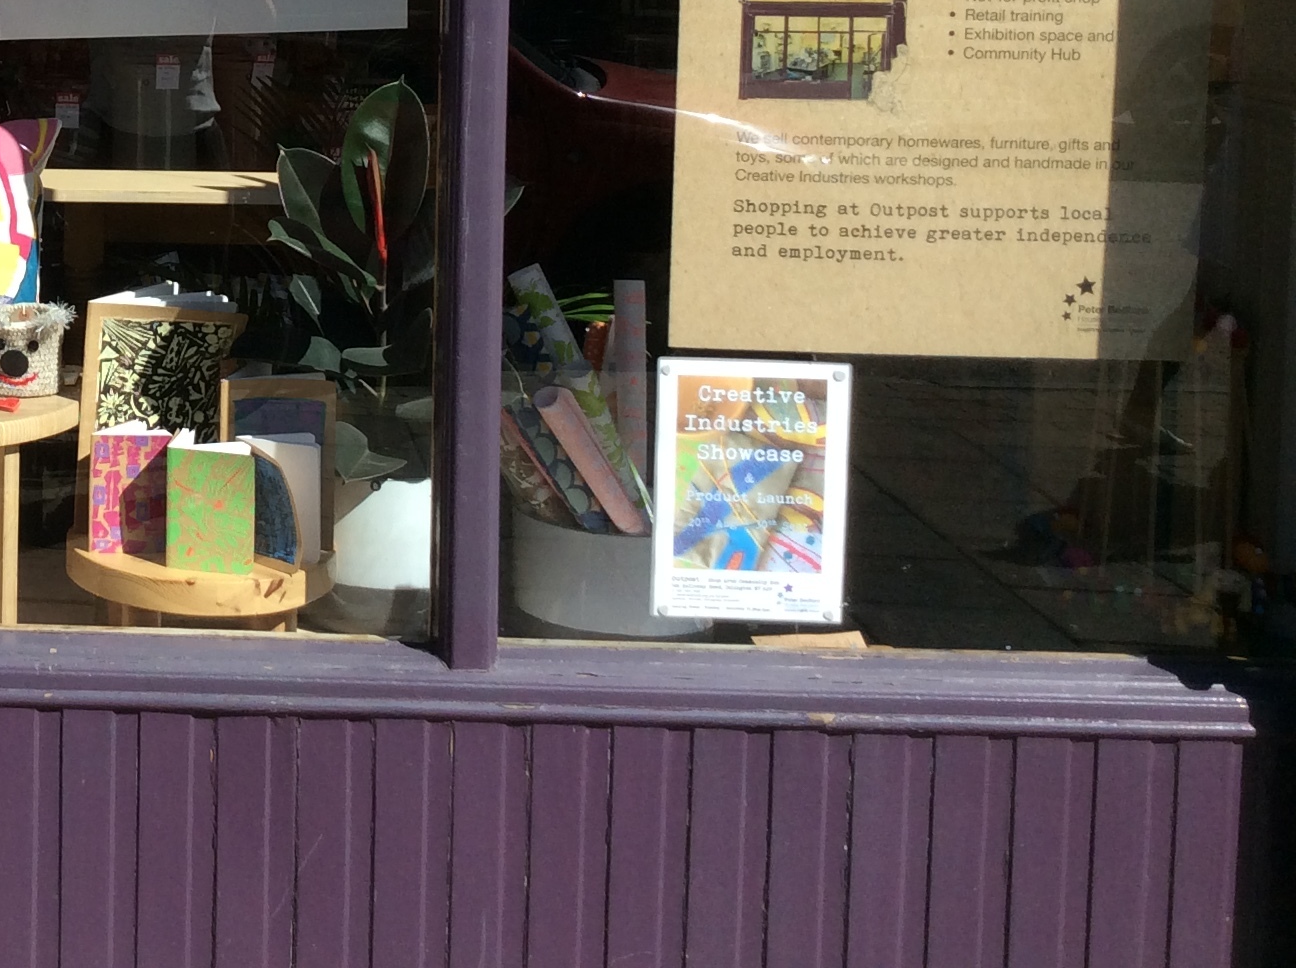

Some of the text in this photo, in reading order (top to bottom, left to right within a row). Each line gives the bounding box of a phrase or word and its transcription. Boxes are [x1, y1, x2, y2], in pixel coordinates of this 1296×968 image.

[965, 9, 1064, 25] Retail training
[964, 28, 1115, 44] Exhibition space and
[963, 47, 1081, 63] Community Hub
[737, 132, 1120, 153] We sell contemporary homewares, furniture, gifts and
[736, 151, 770, 165] toys,
[839, 153, 880, 166] which
[885, 157, 907, 166] are
[912, 154, 978, 170] designed
[983, 157, 1010, 168] and
[1014, 157, 1091, 170] handmade
[1095, 159, 1107, 169] in
[1112, 162, 1135, 171] our
[735, 169, 957, 188] Creative Industries workshops.
[733, 199, 1113, 222] Shopping at Outpost supports local
[733, 222, 1151, 245] people to achieve greater independence
[732, 244, 904, 263] and employment.
[698, 385, 805, 404] Creative
[684, 414, 818, 433] Industries
[697, 444, 804, 462] Showcase
[744, 472, 754, 484] &
[686, 491, 813, 505] Product Launch
